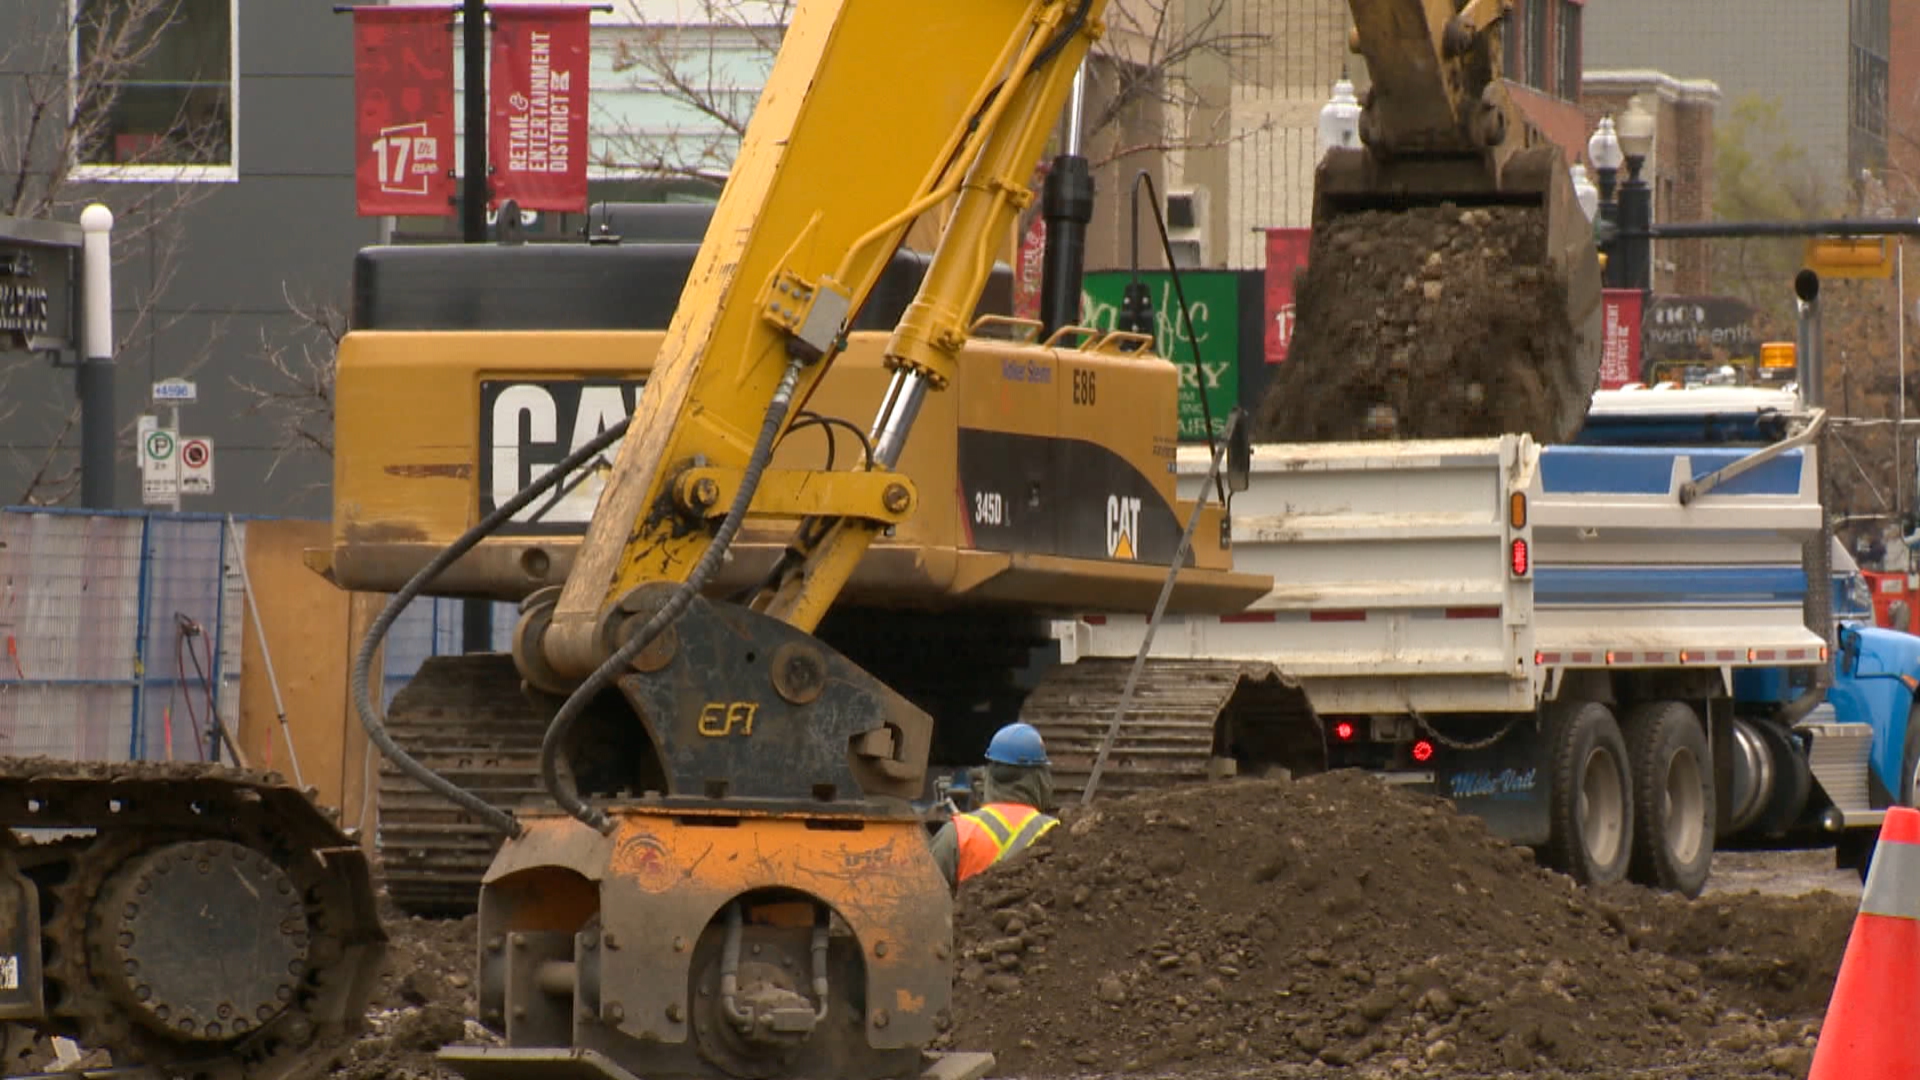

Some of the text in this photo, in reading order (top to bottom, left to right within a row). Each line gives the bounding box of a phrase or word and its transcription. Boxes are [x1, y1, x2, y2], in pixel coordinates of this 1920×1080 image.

[509, 92, 529, 171] RETAIL &
[528, 31, 551, 172] ENTERTAINMENT
[549, 94, 570, 172] DISTRICT
[372, 136, 412, 183] 17
[1073, 368, 1096, 407] E86
[492, 384, 647, 524] CA
[975, 491, 1001, 525] 345D
[1106, 494, 1141, 560] CAT
